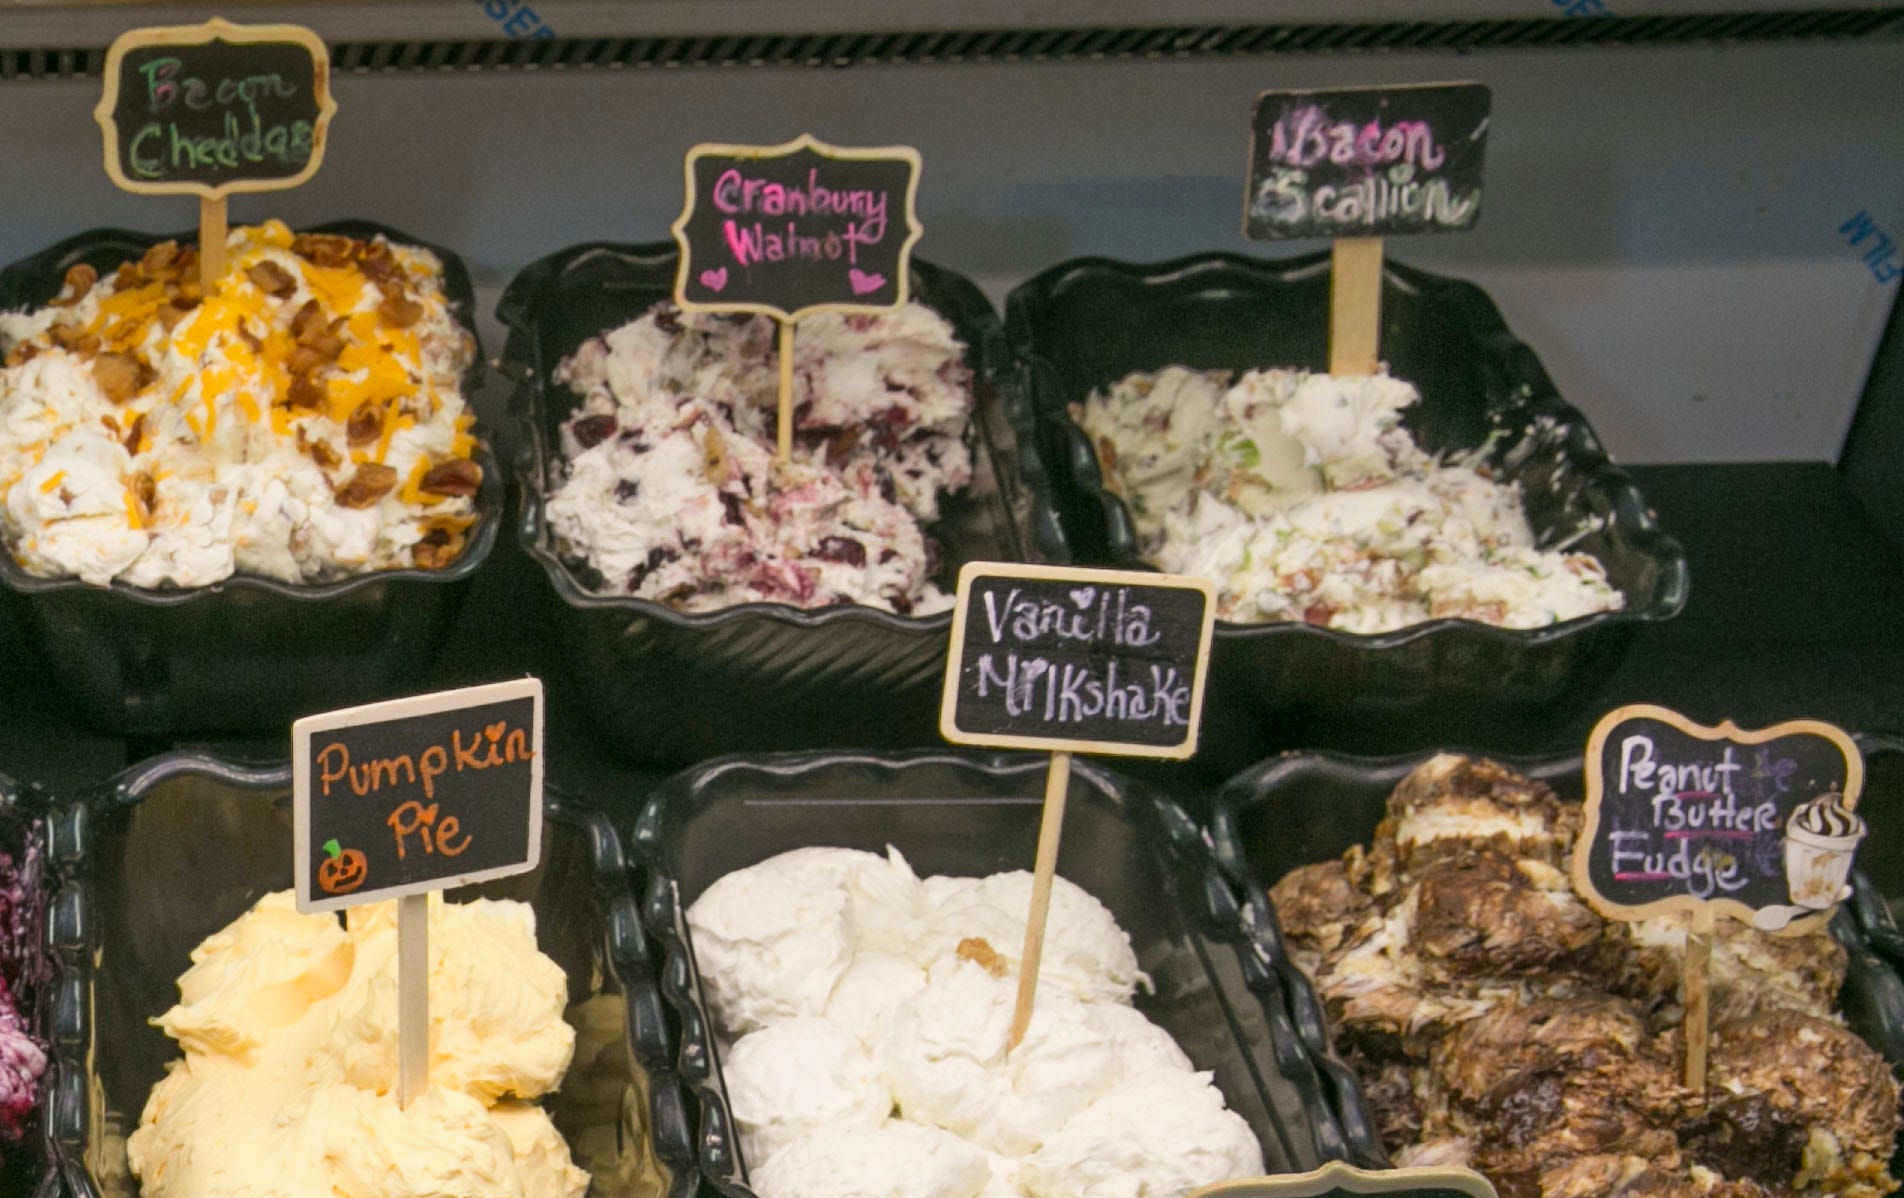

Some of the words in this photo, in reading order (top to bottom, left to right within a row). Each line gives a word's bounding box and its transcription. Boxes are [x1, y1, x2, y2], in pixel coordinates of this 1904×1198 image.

[713, 168, 888, 244] Cranbury
[984, 586, 1161, 647] Vanilla
[977, 653, 1191, 726] Milkshake
[316, 720, 537, 798] Pumpkin
[1619, 735, 1741, 794] Peanut
[386, 800, 473, 860] Pie
[1609, 830, 1749, 898] Fudge
